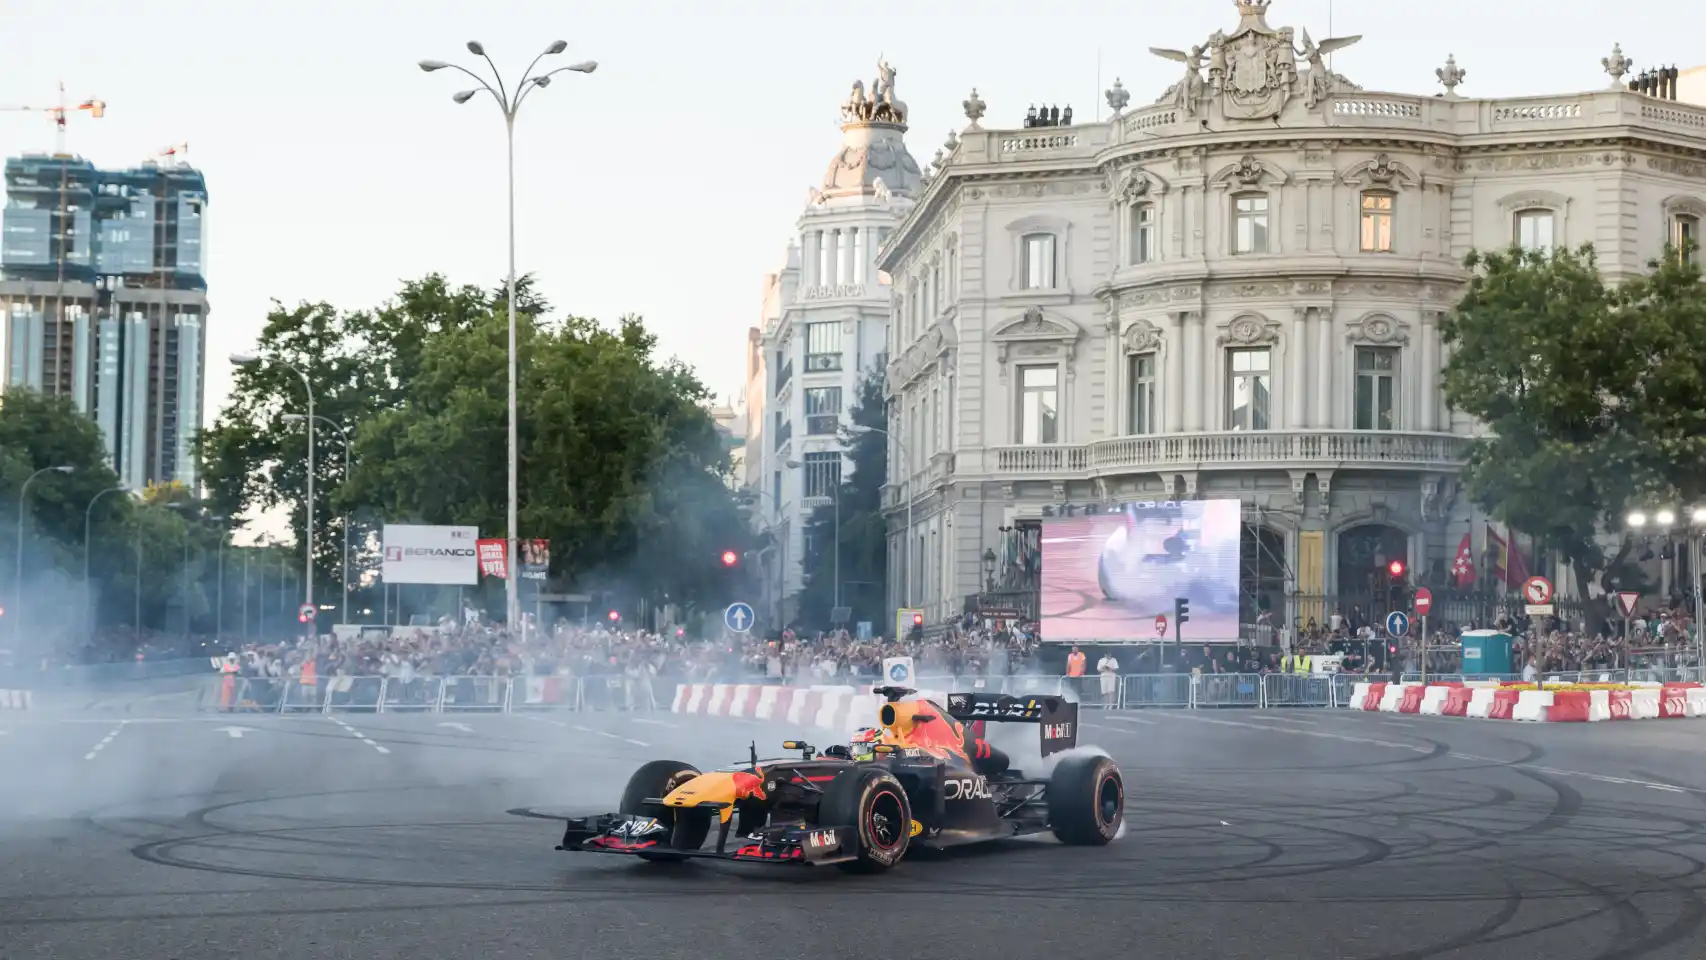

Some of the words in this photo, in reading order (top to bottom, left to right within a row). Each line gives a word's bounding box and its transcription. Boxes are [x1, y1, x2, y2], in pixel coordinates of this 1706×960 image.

[808, 283, 866, 298] ABANCA
[1044, 724, 1064, 740] Mobil
[810, 829, 836, 848] Mobil
